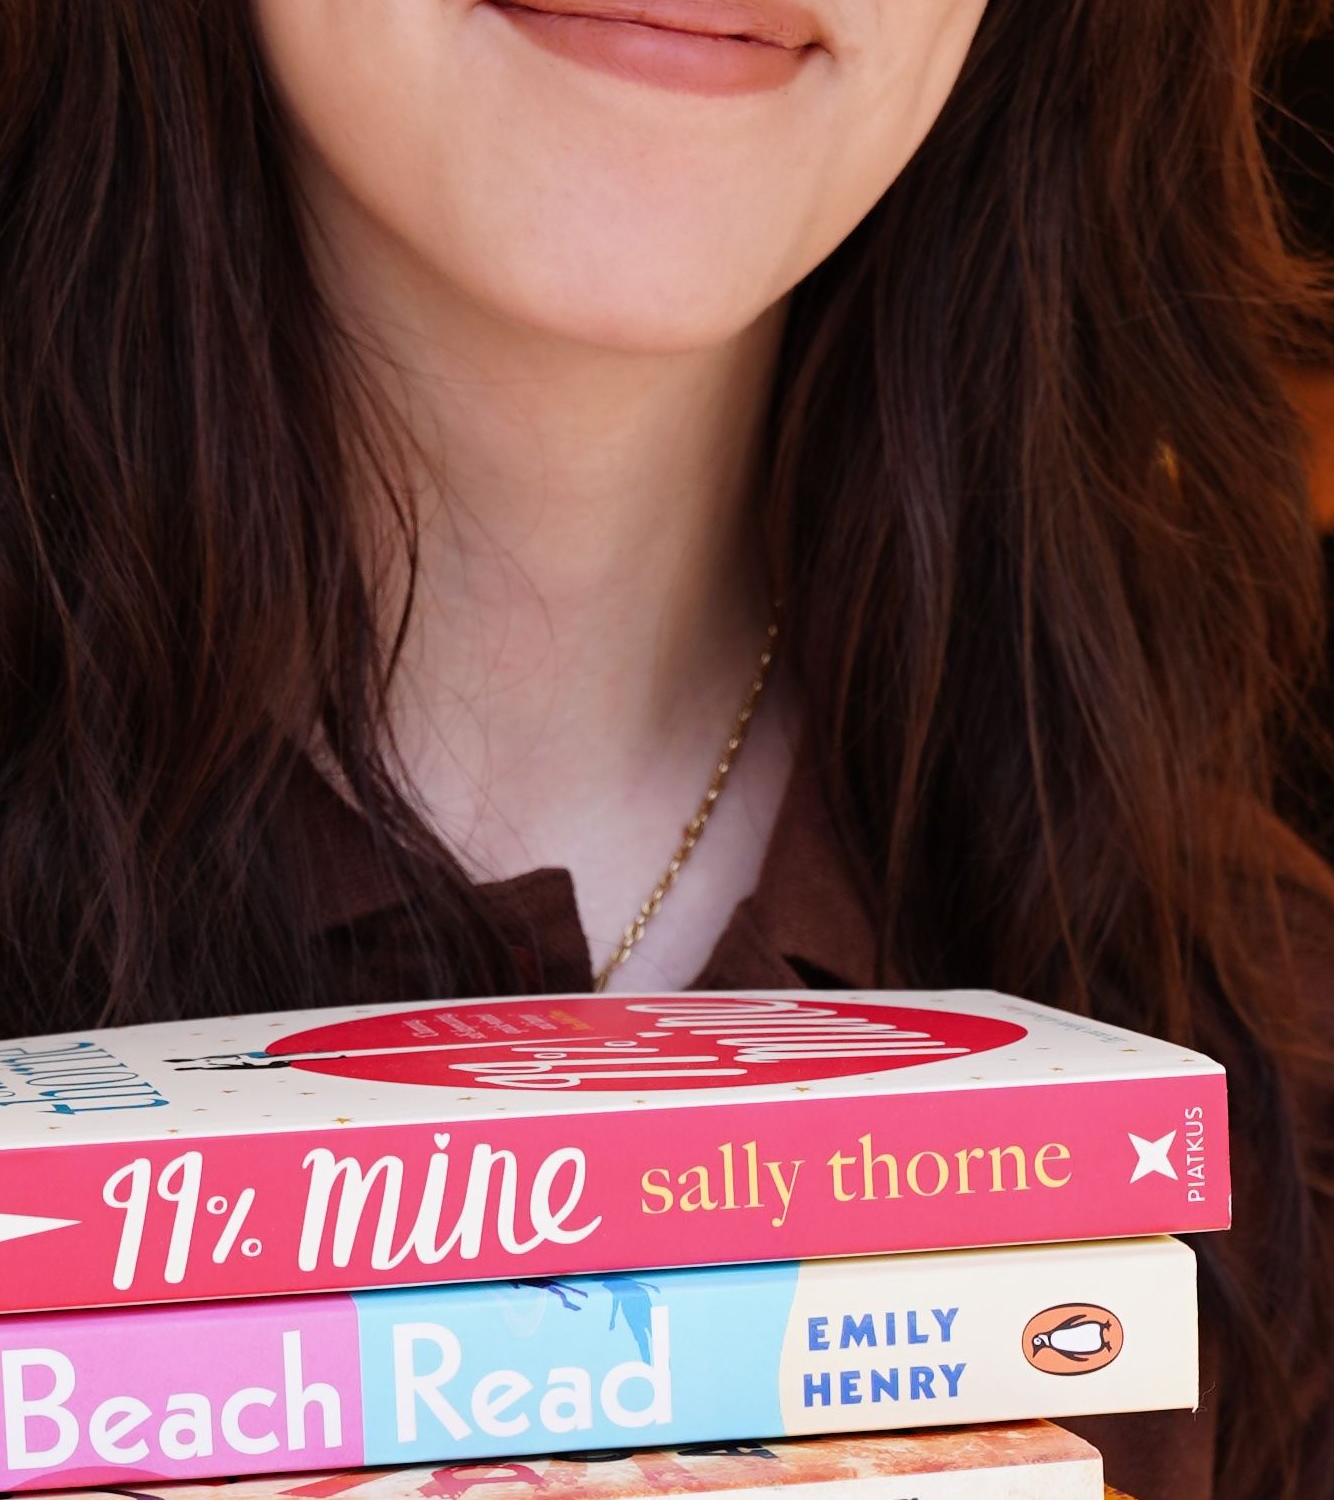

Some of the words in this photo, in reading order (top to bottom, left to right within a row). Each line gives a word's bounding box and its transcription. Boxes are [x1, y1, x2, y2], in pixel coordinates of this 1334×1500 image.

[1187, 1106, 1205, 1202] PIATKUS
[102, 1151, 263, 1290] 99%
[298, 1133, 603, 1271] mine
[640, 1139, 804, 1228] sally
[826, 1133, 1072, 1202] thorne
[807, 1307, 961, 1351] EMILY
[1, 1330, 343, 1471] Beach
[392, 1306, 672, 1445] Read
[802, 1362, 967, 1407] HENRY
